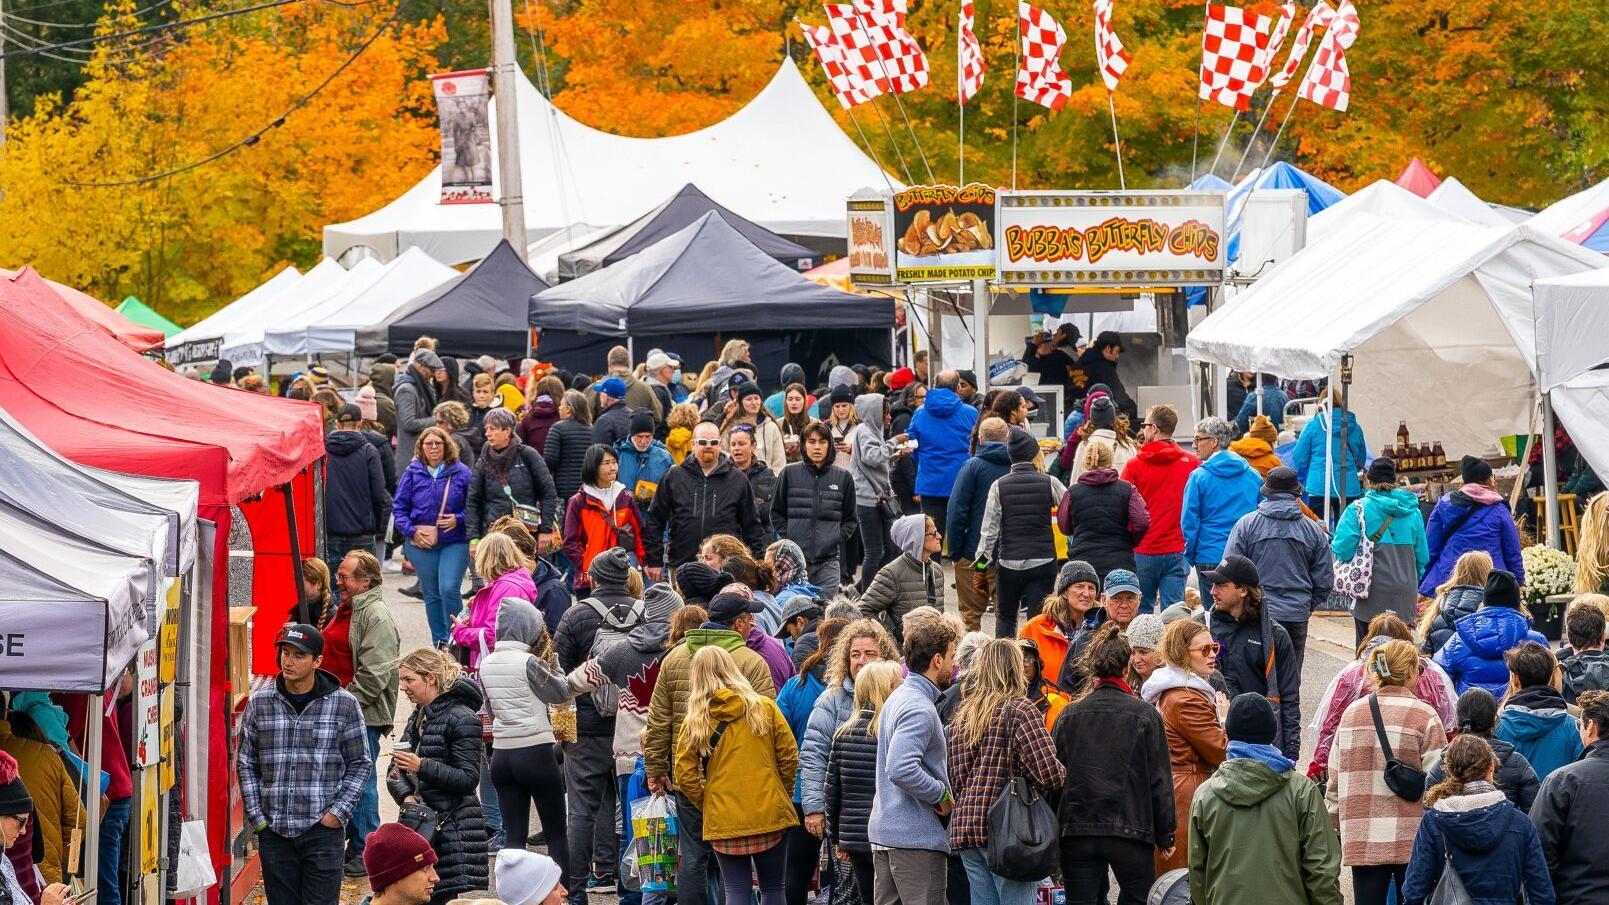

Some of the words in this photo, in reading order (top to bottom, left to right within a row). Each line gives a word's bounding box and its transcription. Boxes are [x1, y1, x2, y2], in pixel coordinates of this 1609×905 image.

[895, 187, 958, 209] BUTTERFLY
[960, 185, 994, 204] CHIPS
[1006, 225, 1083, 263] BUBBA'S
[1085, 218, 1168, 263] BUTTERFLY
[1169, 220, 1219, 262] CHIPS
[897, 269, 926, 279] FRESHLY
[927, 269, 947, 278] MADE
[949, 268, 976, 278] POTATO
